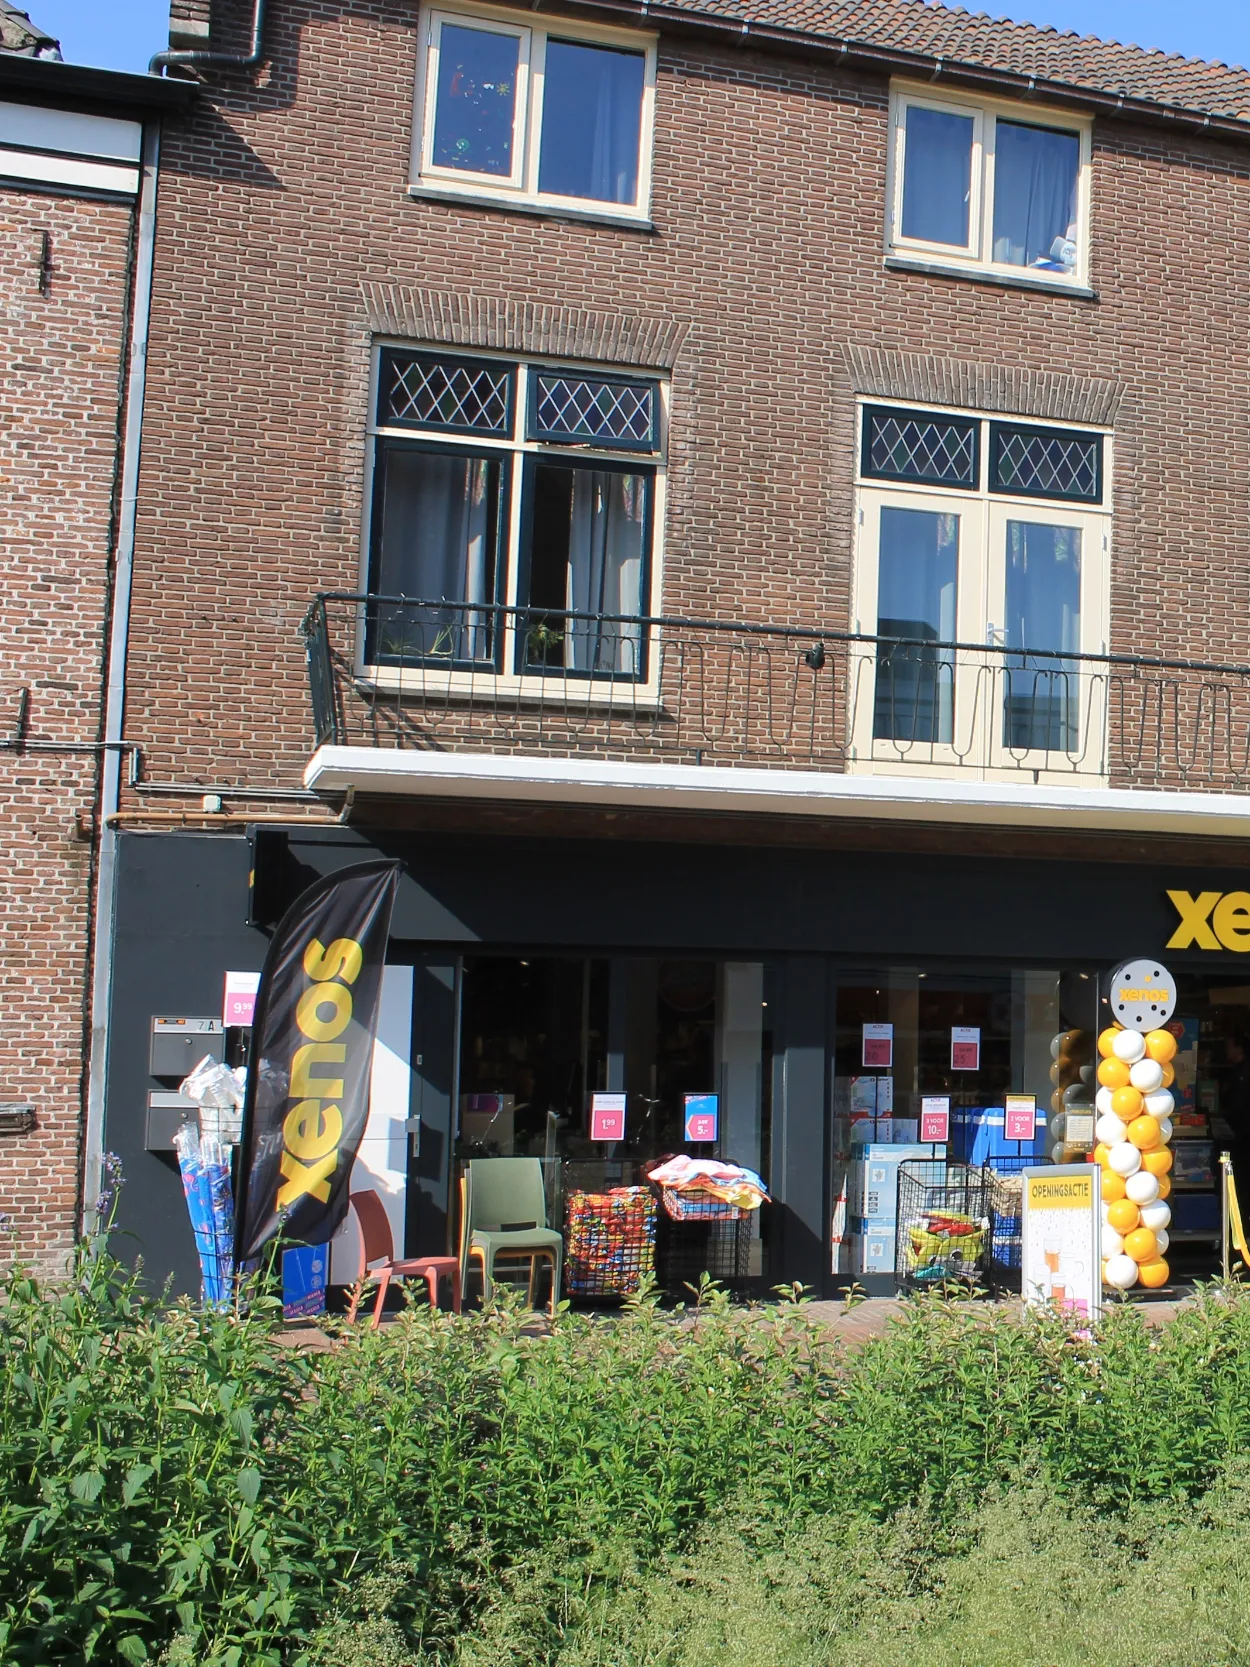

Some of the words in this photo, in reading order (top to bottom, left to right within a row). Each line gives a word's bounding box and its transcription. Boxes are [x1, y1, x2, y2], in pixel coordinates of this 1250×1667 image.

[1119, 988, 1169, 1002] xenos
[275, 937, 363, 1212] xenos
[602, 1119, 616, 1130] 1.99
[1032, 1183, 1089, 1198] OPENINGSACTIE
